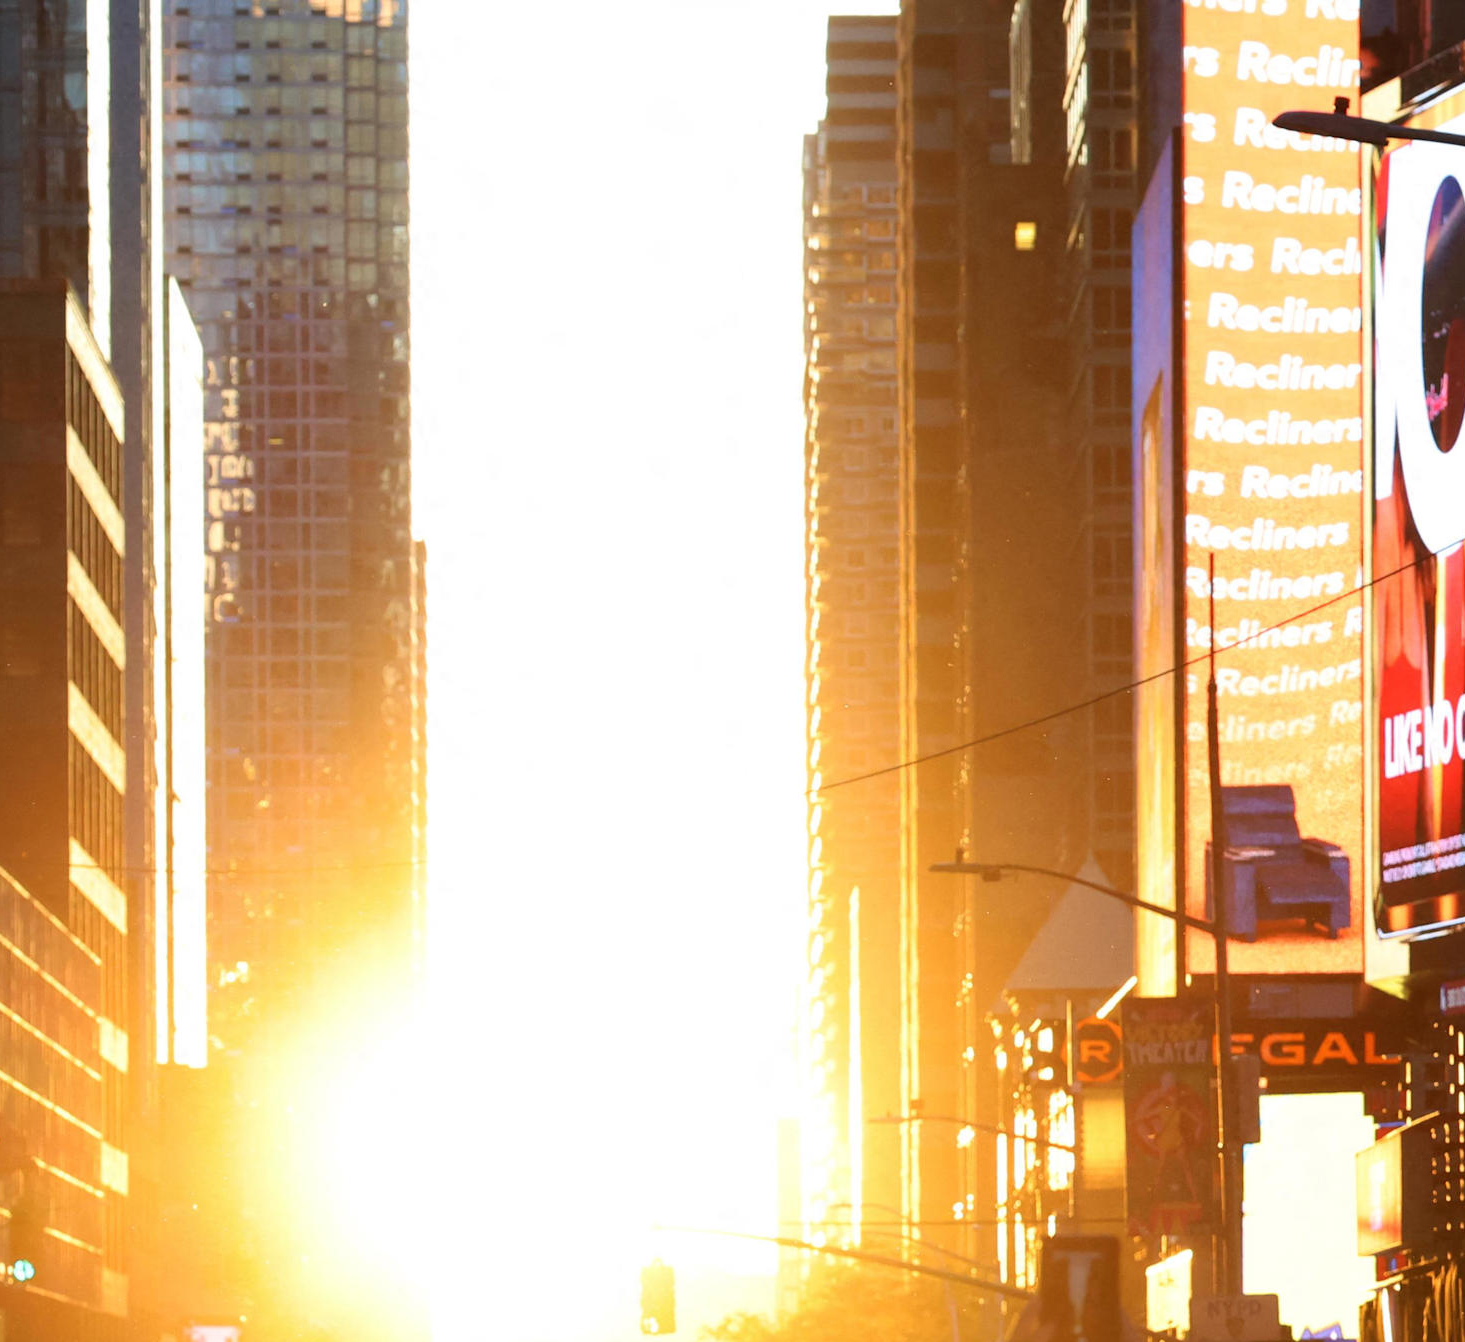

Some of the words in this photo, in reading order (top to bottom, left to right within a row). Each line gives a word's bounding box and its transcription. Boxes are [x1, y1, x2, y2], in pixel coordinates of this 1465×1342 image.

[1187, 240, 1254, 271] ers
[1186, 469, 1225, 496] rs
[1185, 514, 1349, 550] Recliners
[1186, 566, 1345, 600] Recliners
[1216, 659, 1362, 696] Recliners
[1384, 707, 1424, 779] LIKE
[1423, 699, 1455, 768] NO
[1080, 1040, 1111, 1063] R
[1211, 1031, 1402, 1066] EGAL
